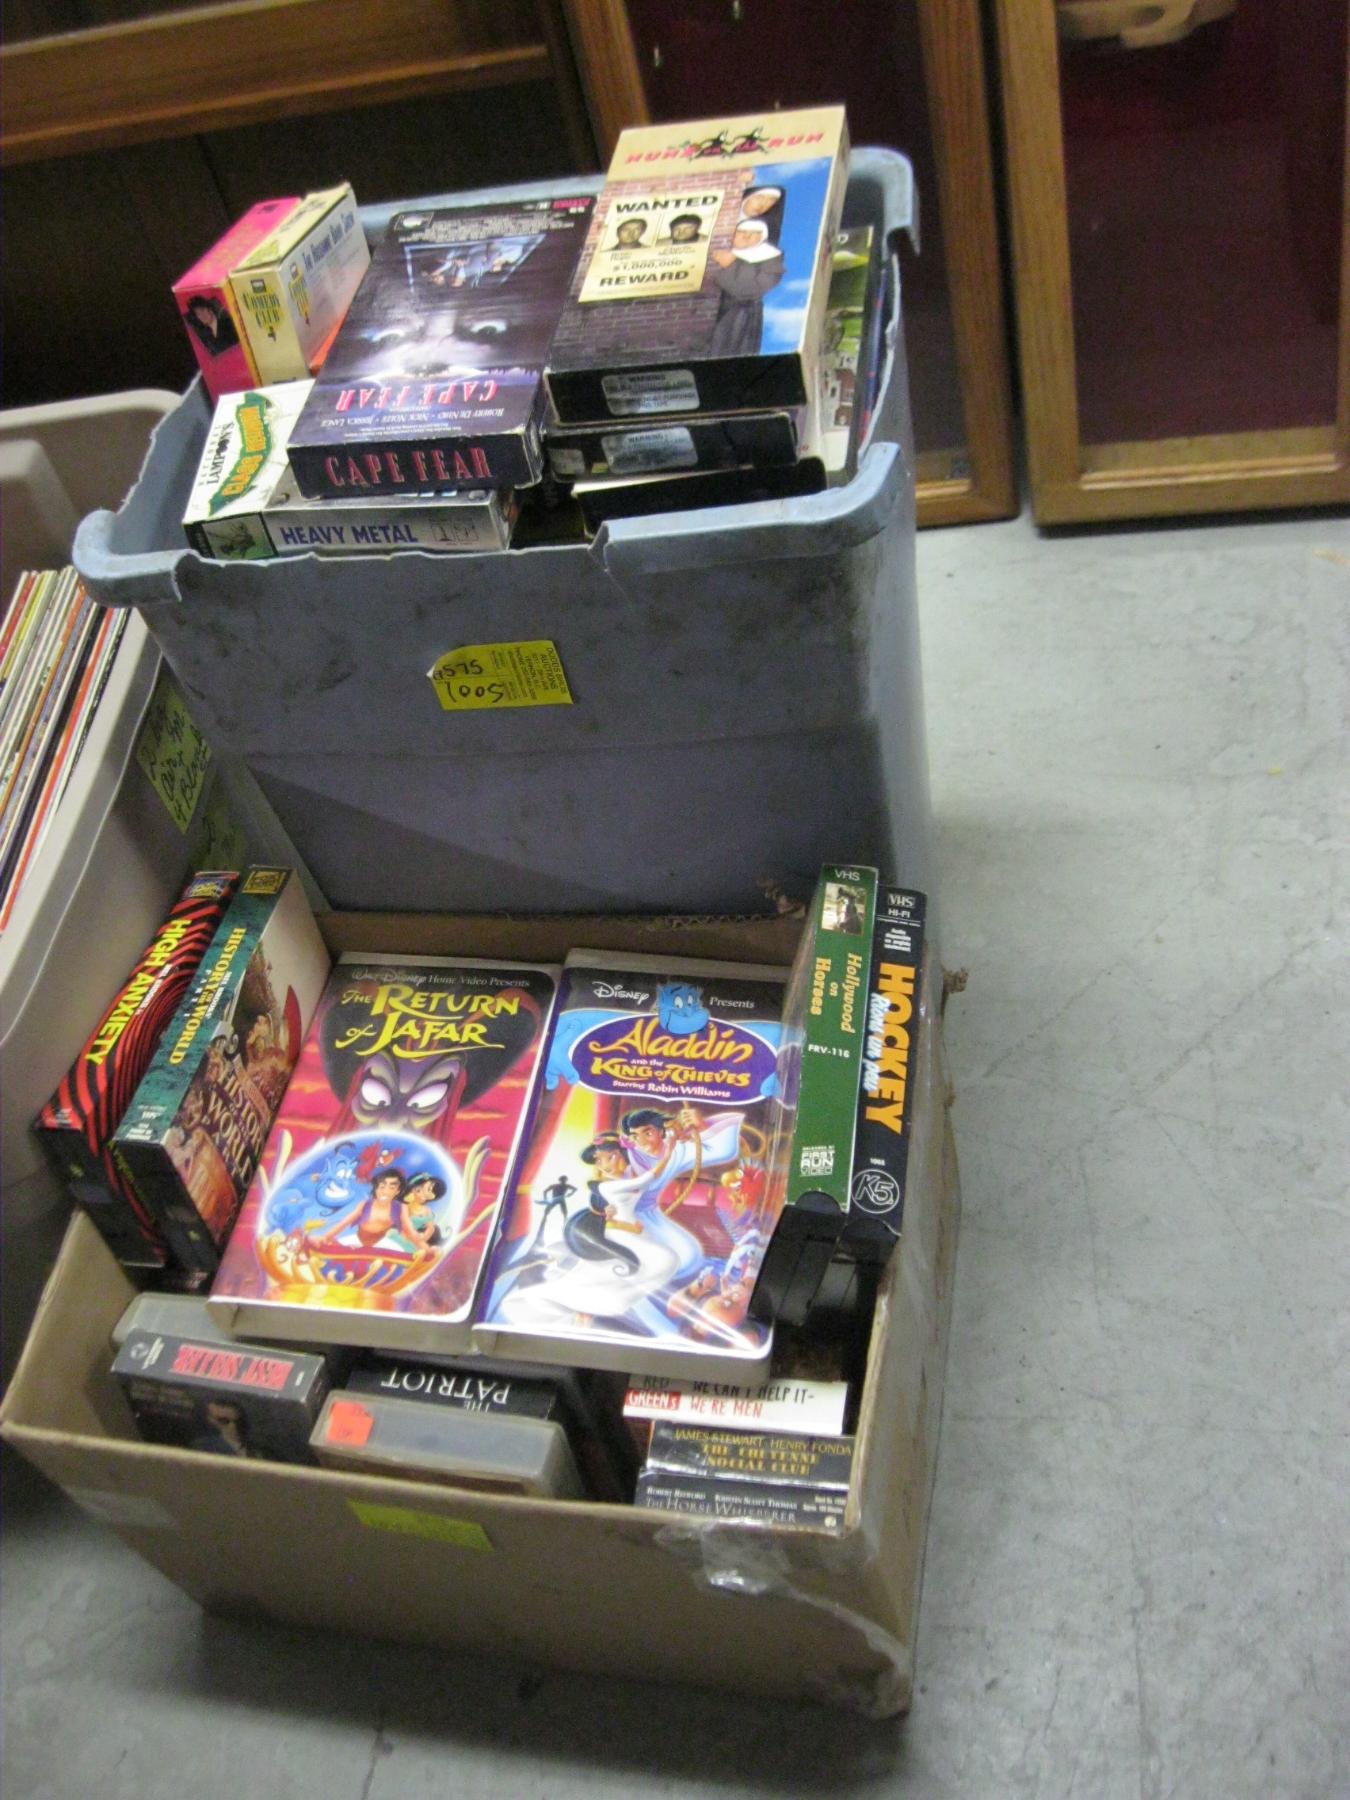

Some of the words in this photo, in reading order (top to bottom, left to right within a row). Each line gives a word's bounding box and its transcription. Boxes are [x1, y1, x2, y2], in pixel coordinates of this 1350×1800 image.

[768, 132, 824, 149] RUN
[616, 196, 718, 213] WANTED
[613, 258, 683, 273] $1,000,000
[600, 271, 689, 287] REWARD
[336, 385, 411, 413] FEAR
[419, 380, 498, 406] CAPE
[320, 419, 347, 428] LANGE
[407, 412, 430, 423] NICK
[206, 422, 235, 485] LAMPOON'S
[324, 452, 405, 487] CAPE
[412, 447, 492, 482] FEAR
[280, 525, 345, 545] HEAVY
[355, 524, 418, 543] METAL
[835, 869, 861, 881] VHS
[888, 893, 915, 908] VHS
[888, 909, 911, 919] HI-FI
[145, 919, 193, 967] HIGH
[205, 927, 247, 990] HISTORY
[382, 969, 427, 986] Disney
[428, 974, 456, 985] Home
[459, 975, 488, 987] Video
[489, 976, 530, 987] Presents
[809, 956, 832, 1016] Horses
[829, 981, 839, 997] on
[341, 990, 373, 1005] THE
[370, 984, 520, 1020] RETURN
[592, 981, 649, 1005] Disney
[709, 996, 755, 1009] Presents
[841, 952, 863, 1034] Hollywood
[86, 972, 156, 1064] ANXIETY
[867, 992, 891, 1034] Rions
[169, 1004, 208, 1064] WORLD
[335, 1024, 377, 1049] of
[355, 1011, 505, 1059] JAFAR
[589, 1018, 753, 1063] Aladdin
[807, 1043, 851, 1058] FRV-116
[865, 962, 916, 1136] HOCKEY
[867, 1035, 884, 1059] un
[591, 1057, 653, 1082] KING
[654, 1068, 669, 1083] of
[667, 1063, 750, 1087] THIEVES
[862, 1058, 880, 1092] peu
[612, 1079, 645, 1091] Starring
[647, 1082, 679, 1094] Robin
[680, 1085, 731, 1099] Williams
[800, 1157, 834, 1168] RUN
[380, 1367, 512, 1404] PATRIOT
[757, 1385, 791, 1403] HELP
[463, 1399, 491, 1413] THE
[732, 1401, 764, 1418] MEN
[673, 1428, 711, 1442] JAMES
[711, 1431, 764, 1446] STEWART
[770, 1438, 808, 1452] HENRY
[811, 1441, 852, 1456] FONDA
[703, 1443, 729, 1455] THE
[738, 1448, 819, 1465] CHEYENNE
[706, 1455, 764, 1472] SOCIAL
[770, 1460, 811, 1476] CLUB
[664, 1497, 711, 1514] HORSE
[768, 1499, 798, 1511] THOMAS
